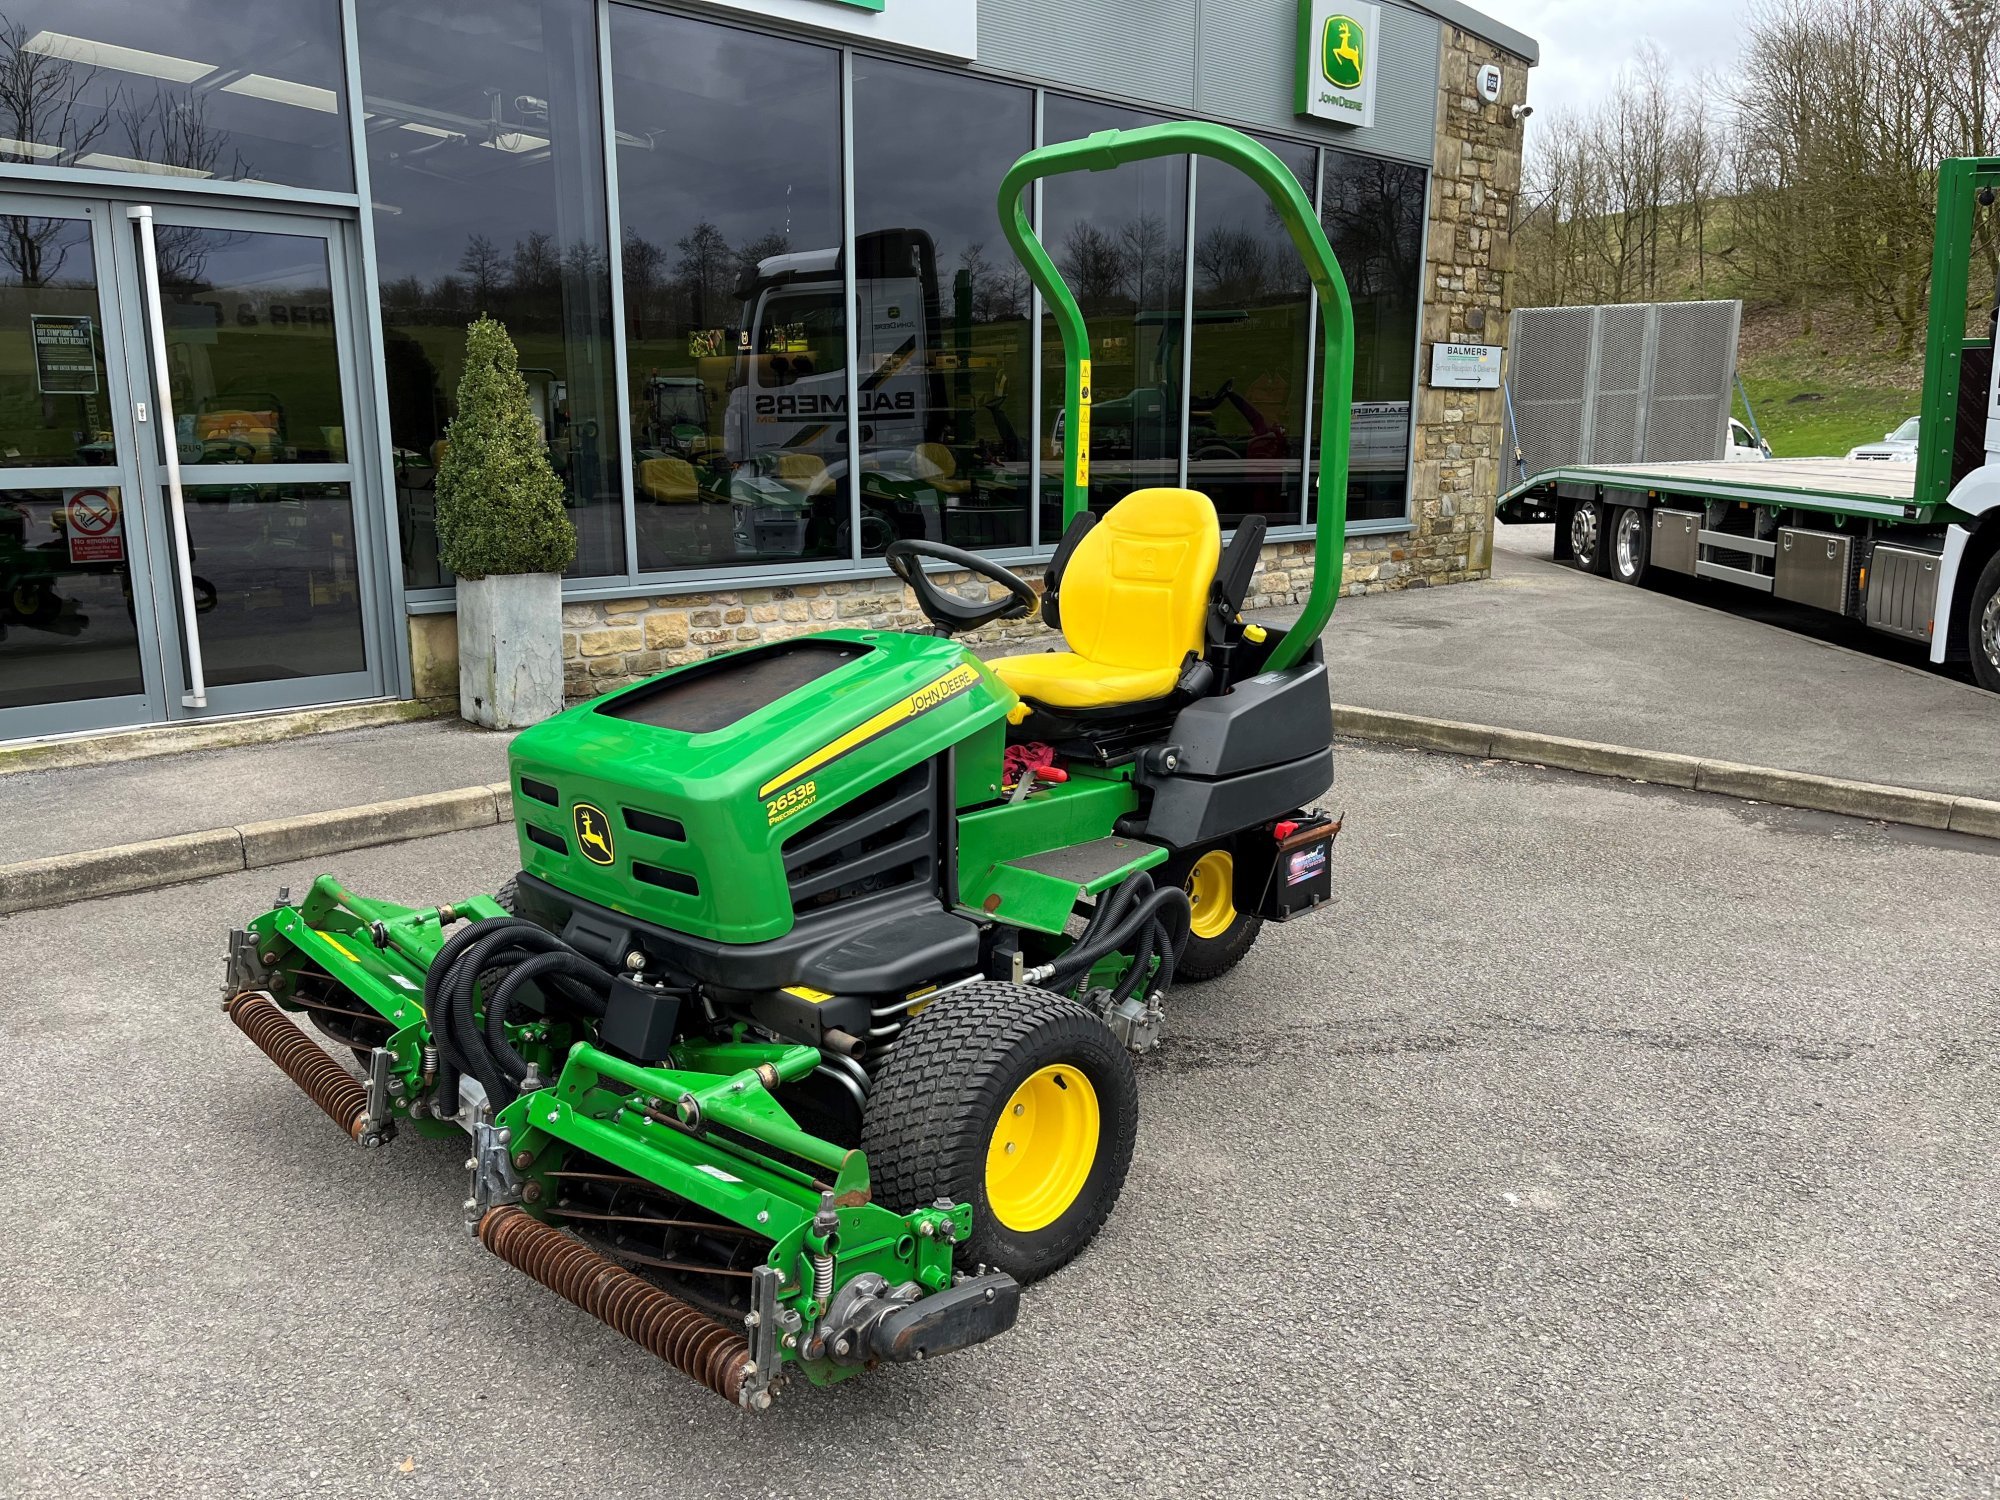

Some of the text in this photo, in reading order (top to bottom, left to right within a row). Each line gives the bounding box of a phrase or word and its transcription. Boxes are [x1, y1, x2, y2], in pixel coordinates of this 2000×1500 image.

[1447, 346, 1488, 356] BALMERS
[910, 671, 972, 714] JOHN DEERE
[767, 781, 816, 818] 2653B
